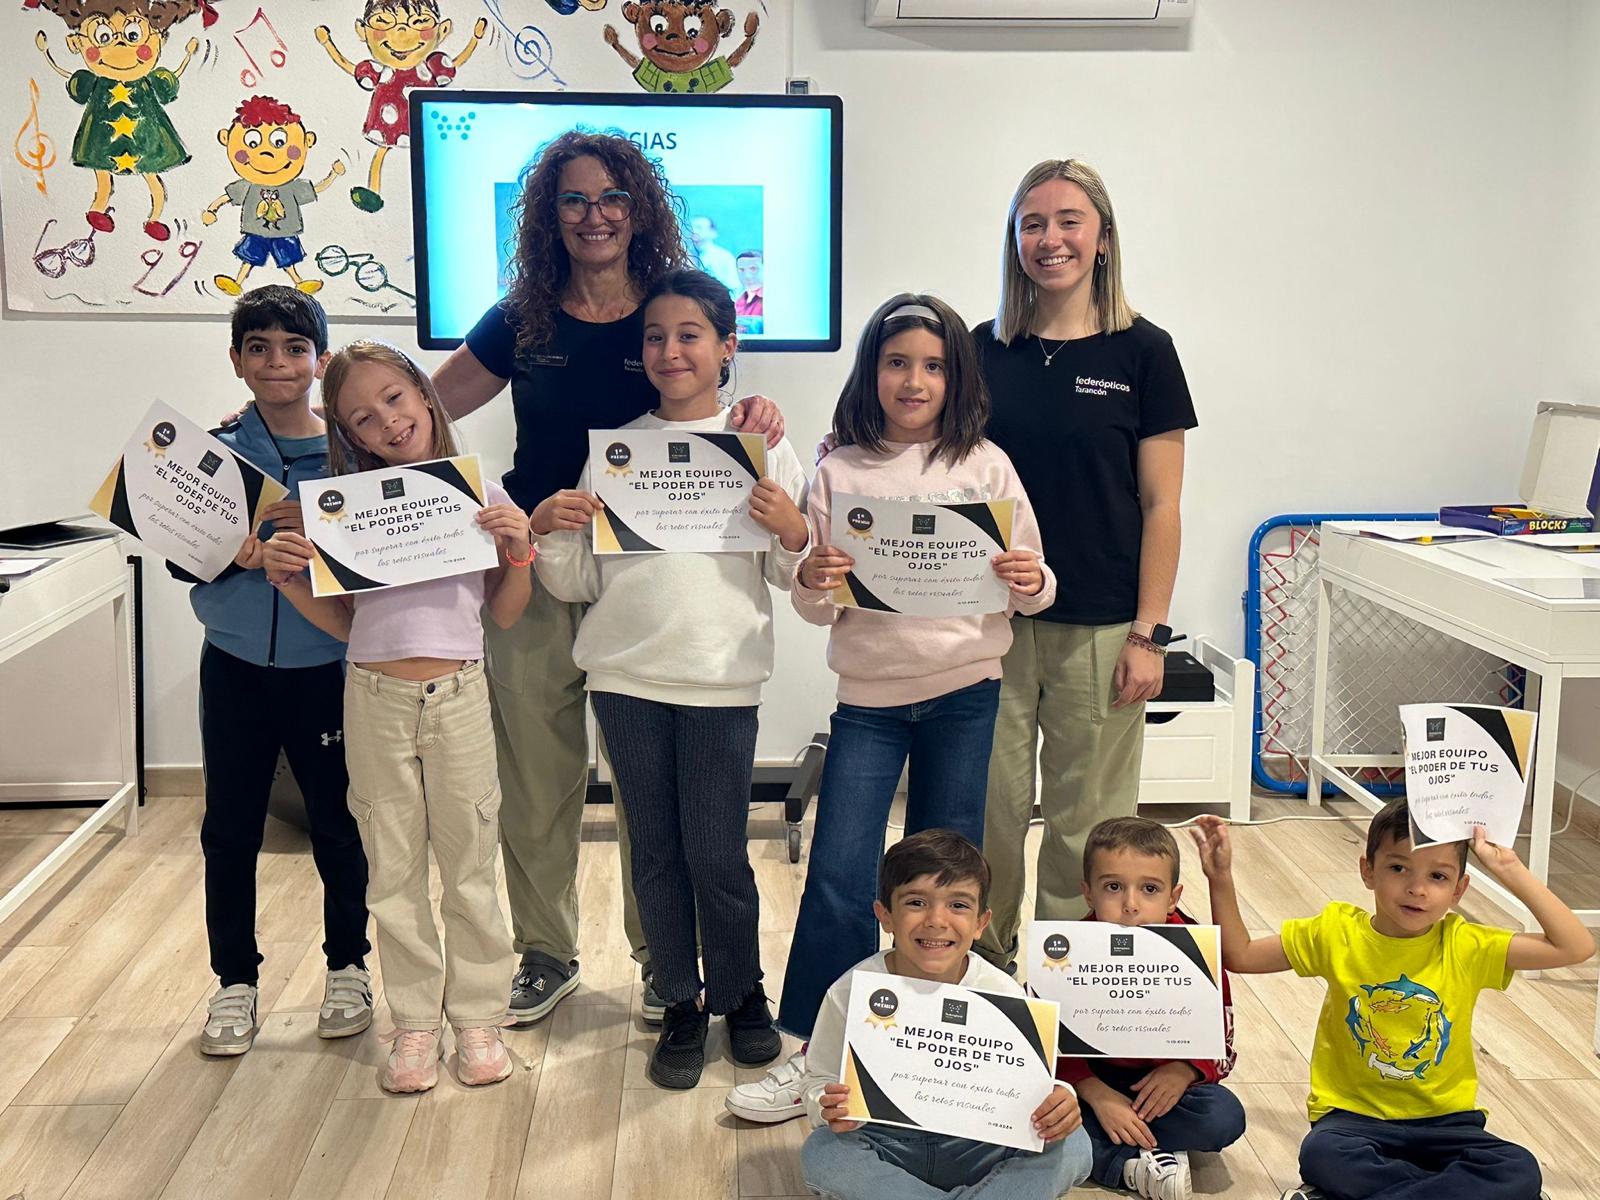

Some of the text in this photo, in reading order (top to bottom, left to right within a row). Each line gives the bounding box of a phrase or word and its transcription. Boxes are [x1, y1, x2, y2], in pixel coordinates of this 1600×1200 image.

[1075, 385, 1107, 395] Tarancón
[1076, 376, 1130, 392] federópticos
[167, 460, 236, 509] MEJOR EQUIPO
[170, 477, 203, 502] PODER
[205, 499, 218, 511] DE
[221, 508, 238, 524] TUS
[355, 496, 449, 520] MEJOR EQUIPO
[635, 510, 649, 518] por
[652, 508, 682, 518] superar
[722, 506, 743, 514] todos
[369, 515, 412, 529] PODER
[417, 510, 433, 520] DE
[436, 504, 461, 516] TUS
[670, 521, 689, 530] retos
[691, 521, 724, 530] visuales
[1529, 520, 1567, 530] BLOCKS
[354, 549, 370, 560] por
[371, 543, 404, 555] superar
[443, 528, 464, 539] todos
[880, 538, 977, 550] MEJOR EQUIPO
[378, 557, 391, 567] los
[392, 554, 412, 564] retos
[414, 547, 447, 561] visuales
[893, 550, 937, 560] PODER
[962, 549, 987, 559] TUS
[872, 573, 887, 582] por
[889, 575, 922, 584] superar
[929, 588, 963, 597] visuales
[1412, 750, 1487, 760] MEJOR EQUIPO
[1419, 762, 1446, 773] PODER
[1470, 762, 1499, 772] TUS
[1128, 964, 1179, 973] EQUIPO
[1092, 977, 1138, 985] PODER
[1164, 977, 1192, 985] TUS
[1073, 1008, 1089, 1018] por
[1091, 1008, 1124, 1018] superar
[1144, 1007, 1166, 1017] éxito
[1169, 1006, 1192, 1016] todos
[1097, 1023, 1171, 1032] los retos visuales
[904, 1026, 1013, 1051] MEJOR EQUIPO
[917, 1042, 967, 1058] PODER
[972, 1051, 992, 1061] DE
[996, 1054, 1025, 1067] TUS
[891, 1071, 909, 1081] por
[911, 1074, 949, 1087] superar
[970, 1081, 993, 1094] éxito
[995, 1085, 1021, 1099] todos
[914, 1091, 996, 1114] los retos visuales
